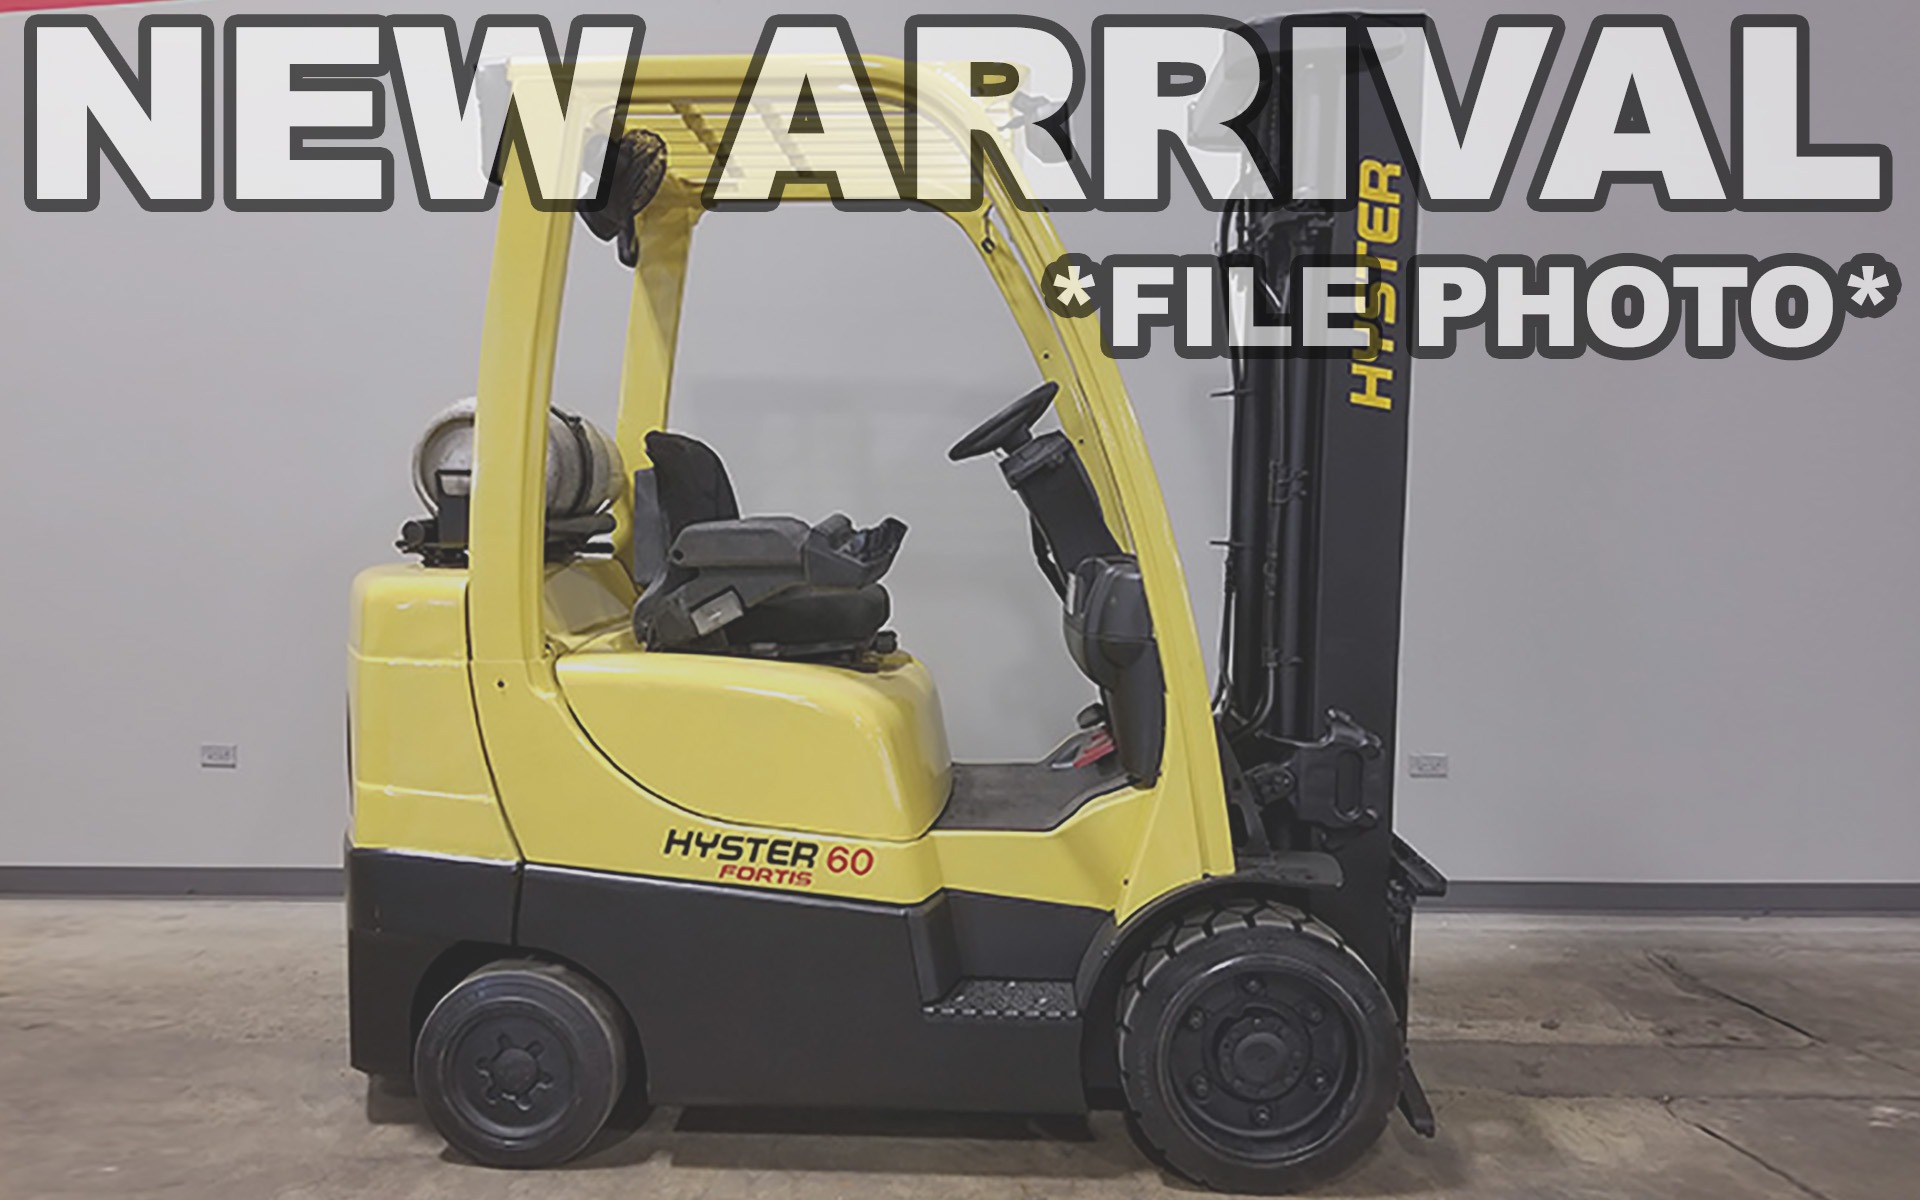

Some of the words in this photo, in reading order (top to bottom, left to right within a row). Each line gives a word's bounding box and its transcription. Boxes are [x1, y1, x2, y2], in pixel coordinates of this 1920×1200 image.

[1350, 158, 1401, 411] HYSTER
[663, 829, 819, 868] HYSTER
[826, 846, 874, 876] 60
[719, 864, 812, 886] FORTIS
